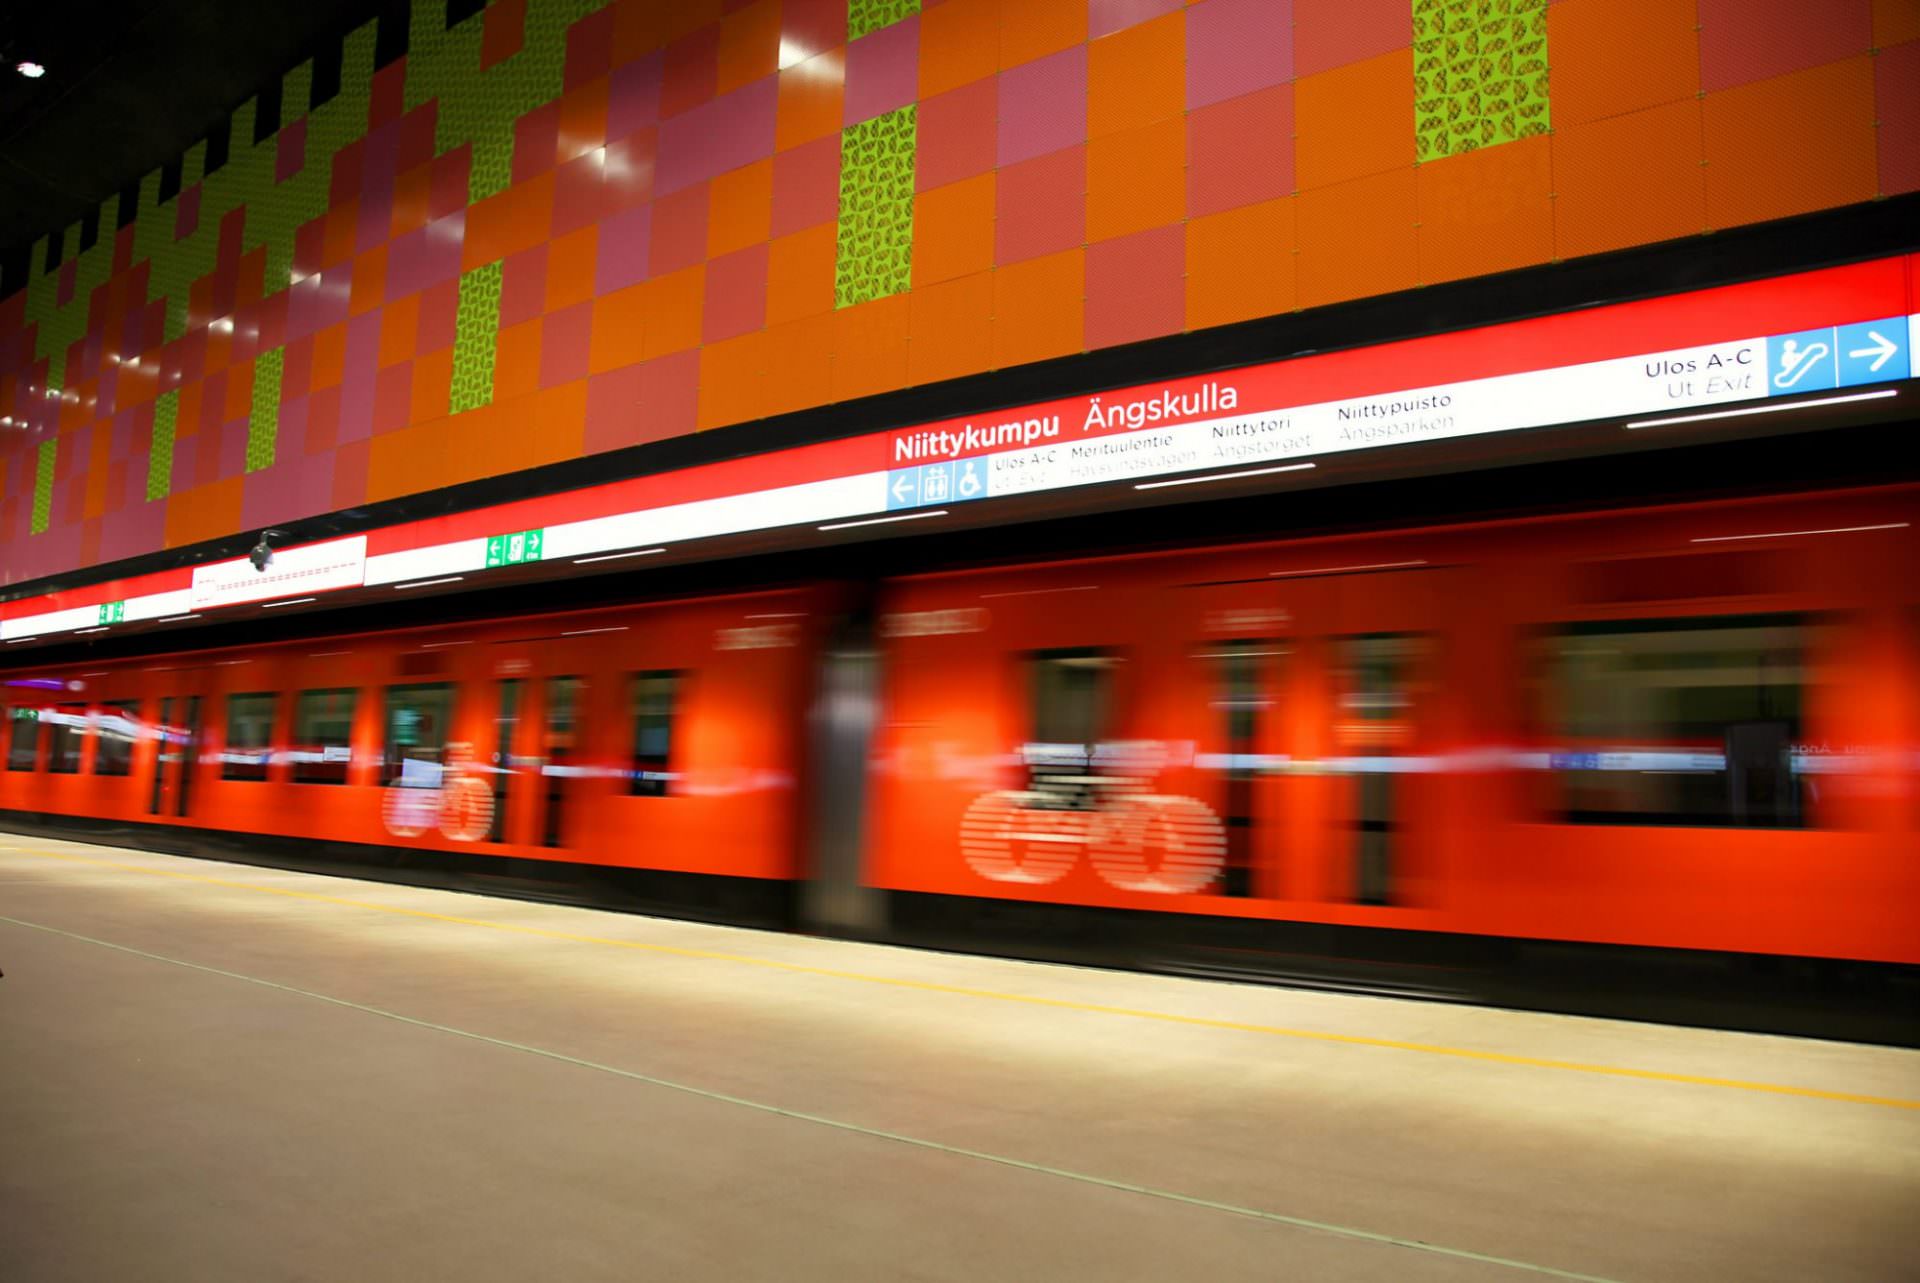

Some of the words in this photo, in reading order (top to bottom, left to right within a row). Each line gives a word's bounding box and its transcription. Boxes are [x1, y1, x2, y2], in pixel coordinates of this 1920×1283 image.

[1645, 360, 1697, 378] Ulos
[1706, 348, 1752, 369] A-C
[1667, 381, 1694, 398] Ut
[1706, 373, 1752, 394] Exit
[1337, 395, 1452, 421] Niittypuisto
[895, 415, 1060, 461] Niittykumpu
[1083, 382, 1238, 430] Ängskulla
[1212, 416, 1291, 438] Niittytori
